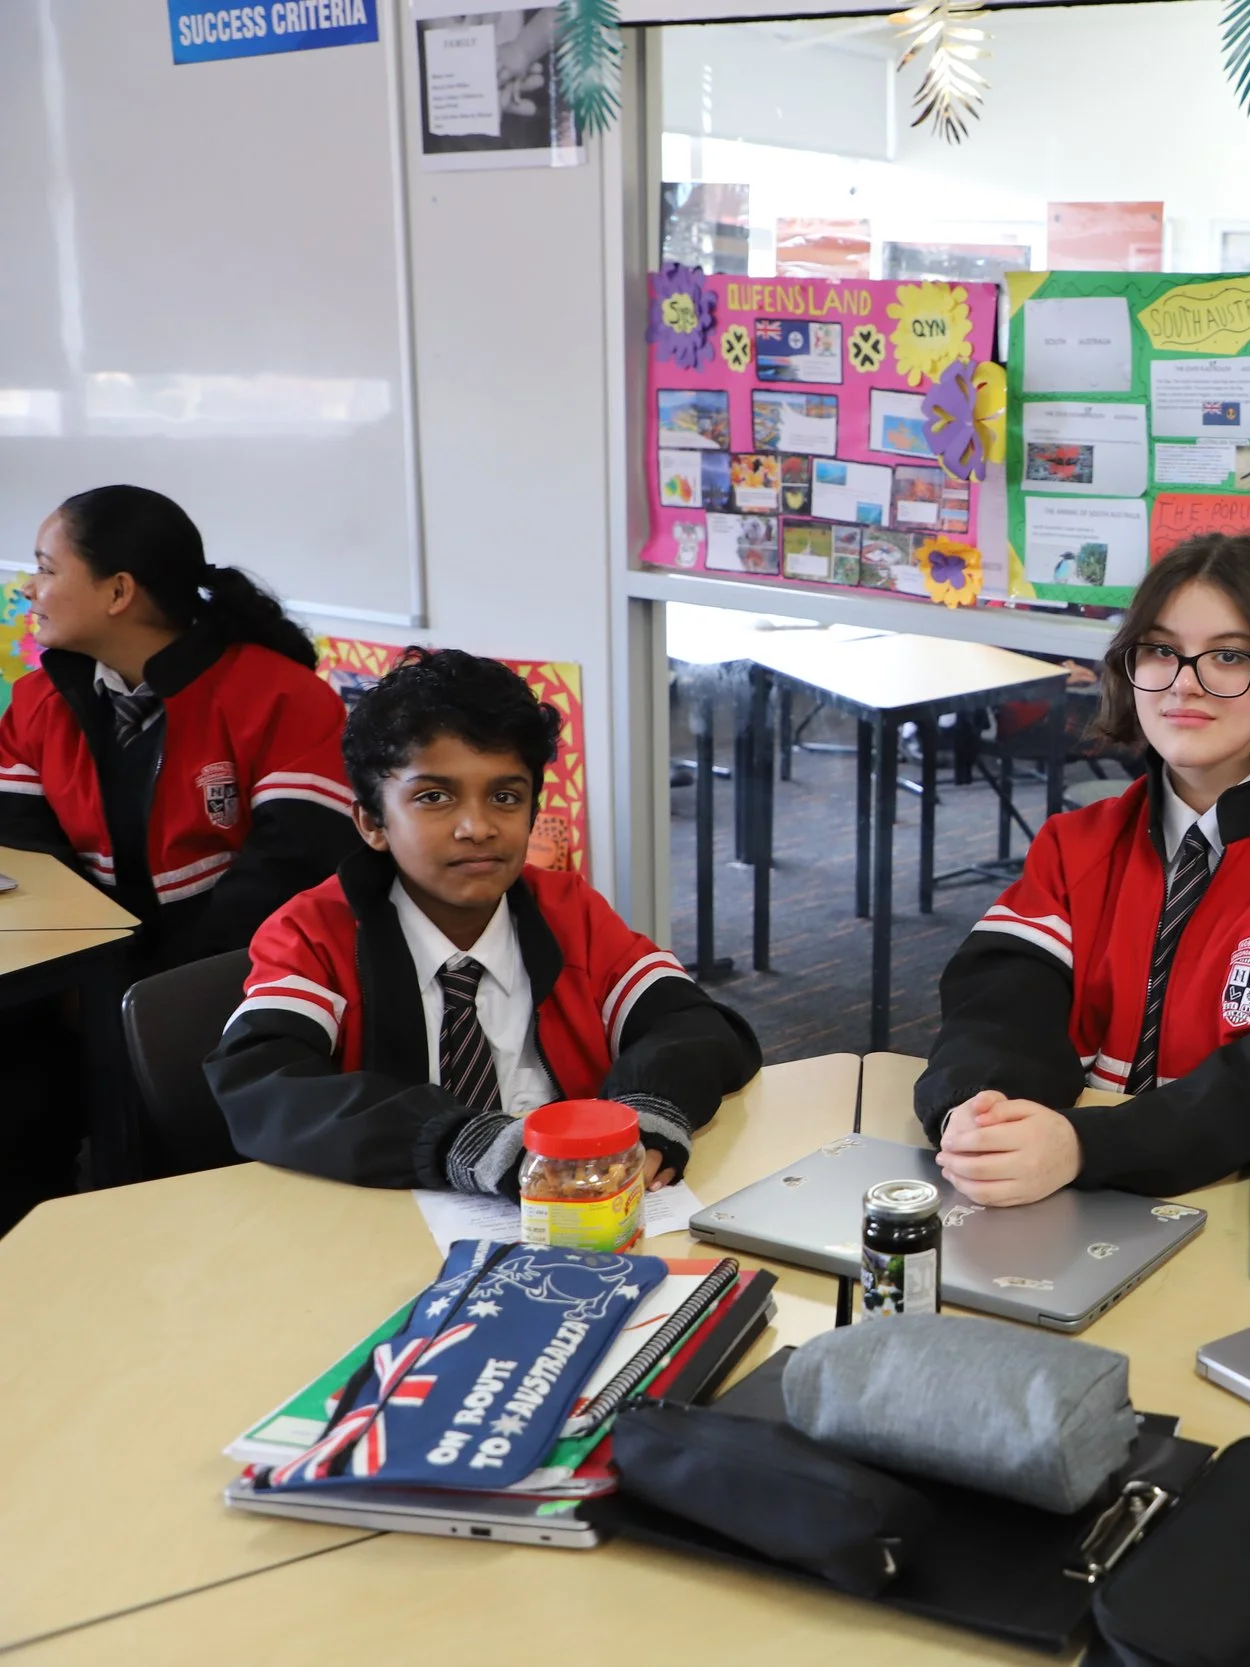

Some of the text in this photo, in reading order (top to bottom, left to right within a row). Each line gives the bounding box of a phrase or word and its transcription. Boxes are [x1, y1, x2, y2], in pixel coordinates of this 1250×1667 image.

[178, 0, 367, 46] SUCCESS CRITERIA
[911, 319, 947, 338] QYN
[1150, 306, 1202, 339] SOUTH
[426, 1358, 519, 1466] ON ROUTE
[469, 1320, 590, 1469] TO AUSTRALIA
